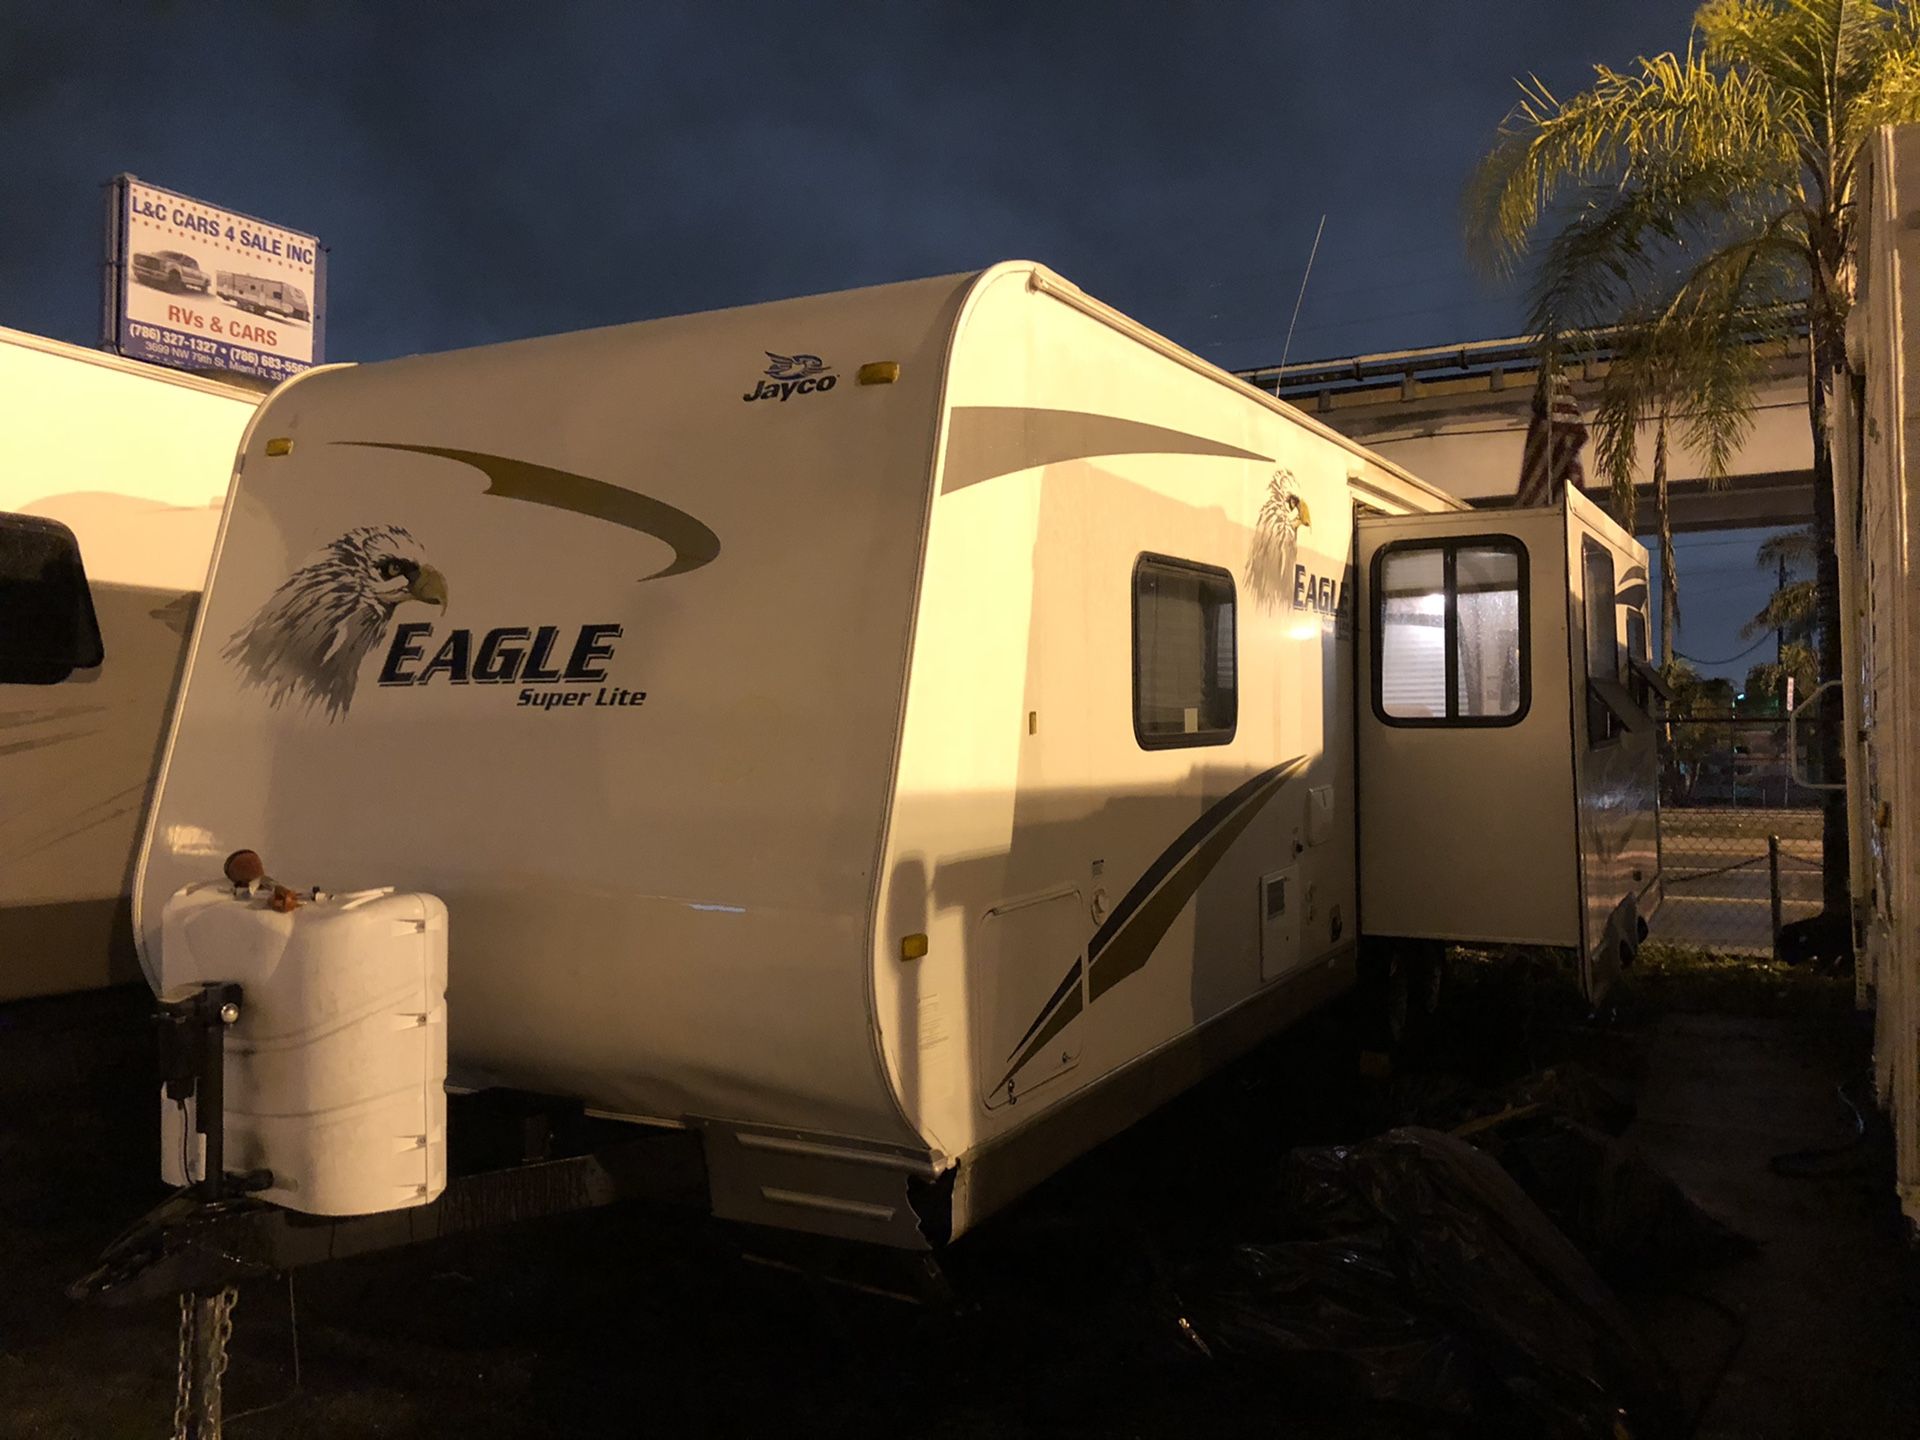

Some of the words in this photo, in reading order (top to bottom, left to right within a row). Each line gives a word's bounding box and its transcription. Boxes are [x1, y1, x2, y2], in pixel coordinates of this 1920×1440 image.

[132, 196, 167, 221] L&C
[173, 209, 220, 237] CARS
[225, 226, 236, 242] 4
[240, 230, 282, 256] SALE
[286, 244, 313, 265] INC
[129, 323, 161, 343] (786)
[162, 331, 218, 354] 327-1327
[230, 347, 258, 367] (786)
[168, 304, 204, 329] RVs
[210, 316, 223, 334] &
[229, 320, 278, 347] CARS
[171, 347, 190, 360] NW
[229, 360, 256, 376] Miami
[257, 367, 269, 378] FL
[743, 375, 837, 402] Jayco
[377, 622, 623, 687] EAGLE
[517, 688, 592, 711] Super
[595, 687, 648, 706] Lite
